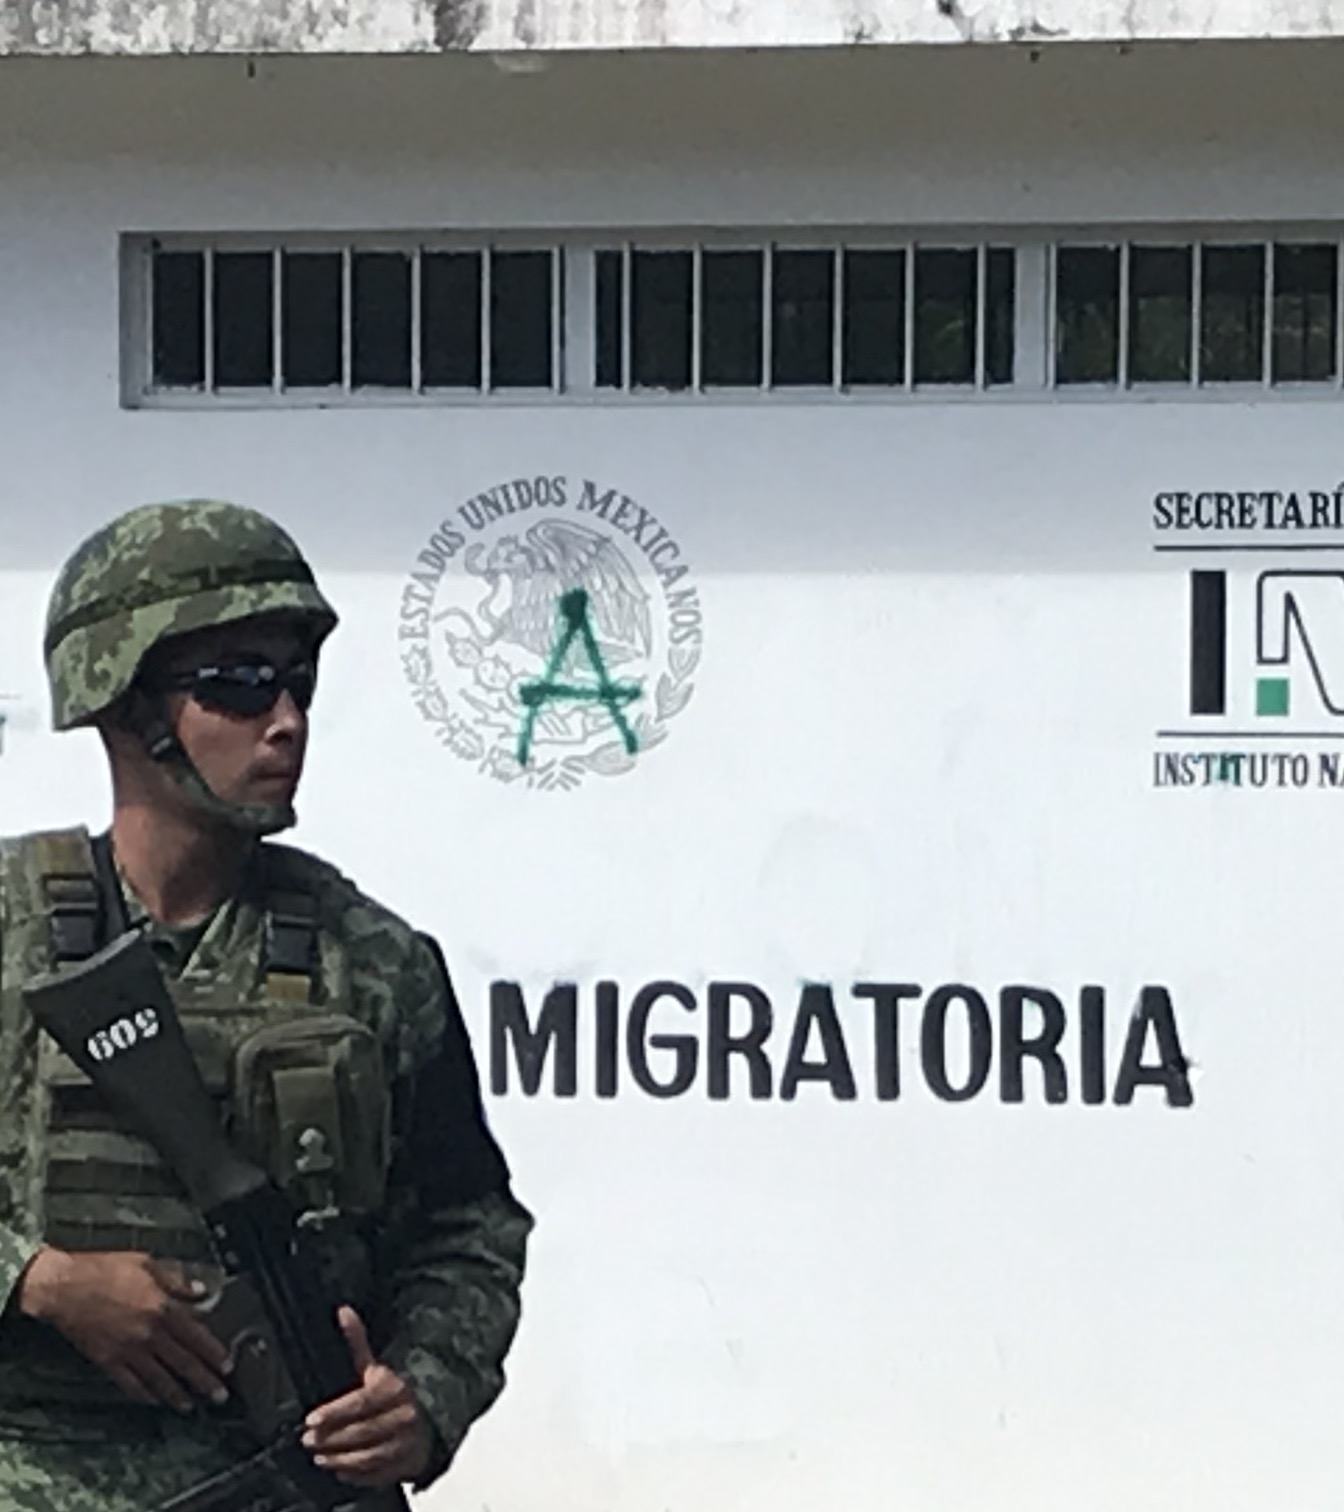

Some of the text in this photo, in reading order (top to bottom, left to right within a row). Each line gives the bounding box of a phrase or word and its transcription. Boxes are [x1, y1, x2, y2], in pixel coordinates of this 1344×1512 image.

[398, 475, 703, 646] ESTADOS UNIDOS MEXICANOS
[1154, 750, 1309, 788] INSTITUTO
[489, 980, 1196, 1107] MIGRATORIA
